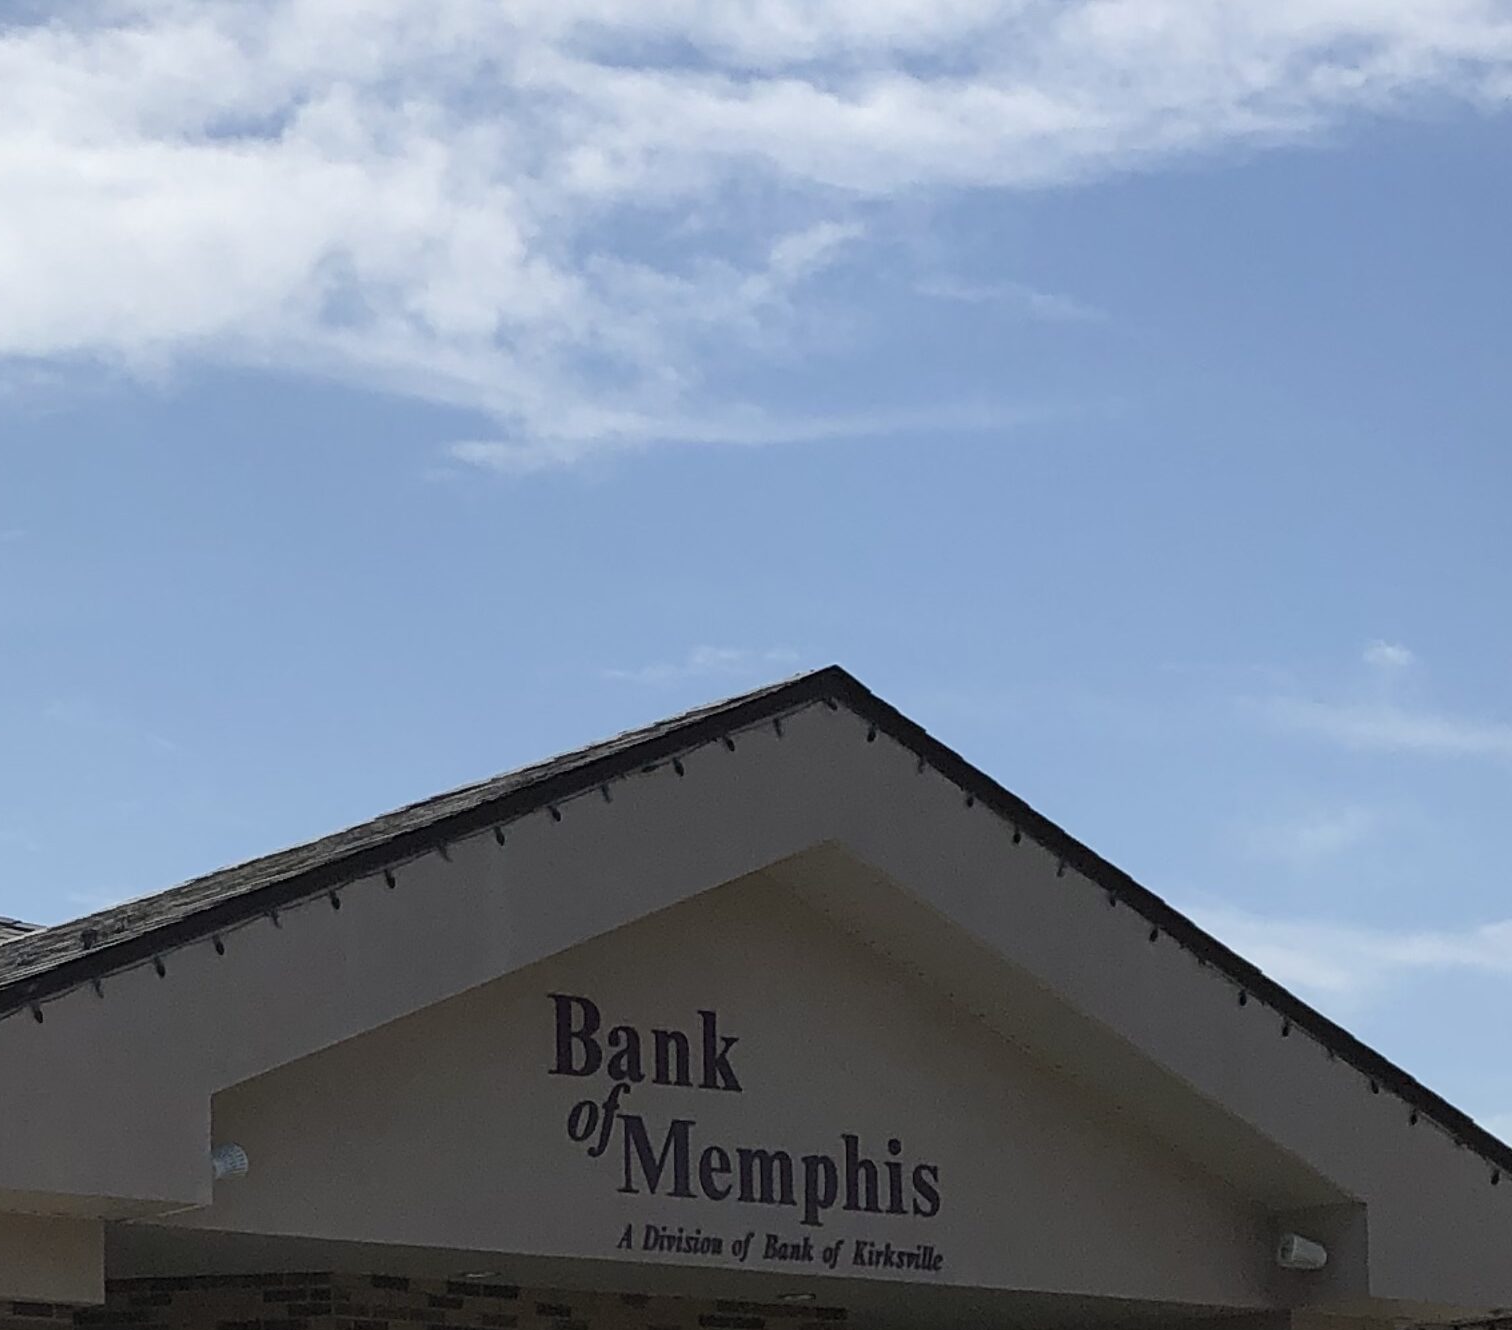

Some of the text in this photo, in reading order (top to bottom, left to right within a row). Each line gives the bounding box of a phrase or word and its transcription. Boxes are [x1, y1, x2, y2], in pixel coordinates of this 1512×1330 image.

[546, 993, 743, 1092] Bank
[567, 1082, 941, 1227] of Memphis
[616, 1223, 944, 1272] A Division of Bank of Kirksville
